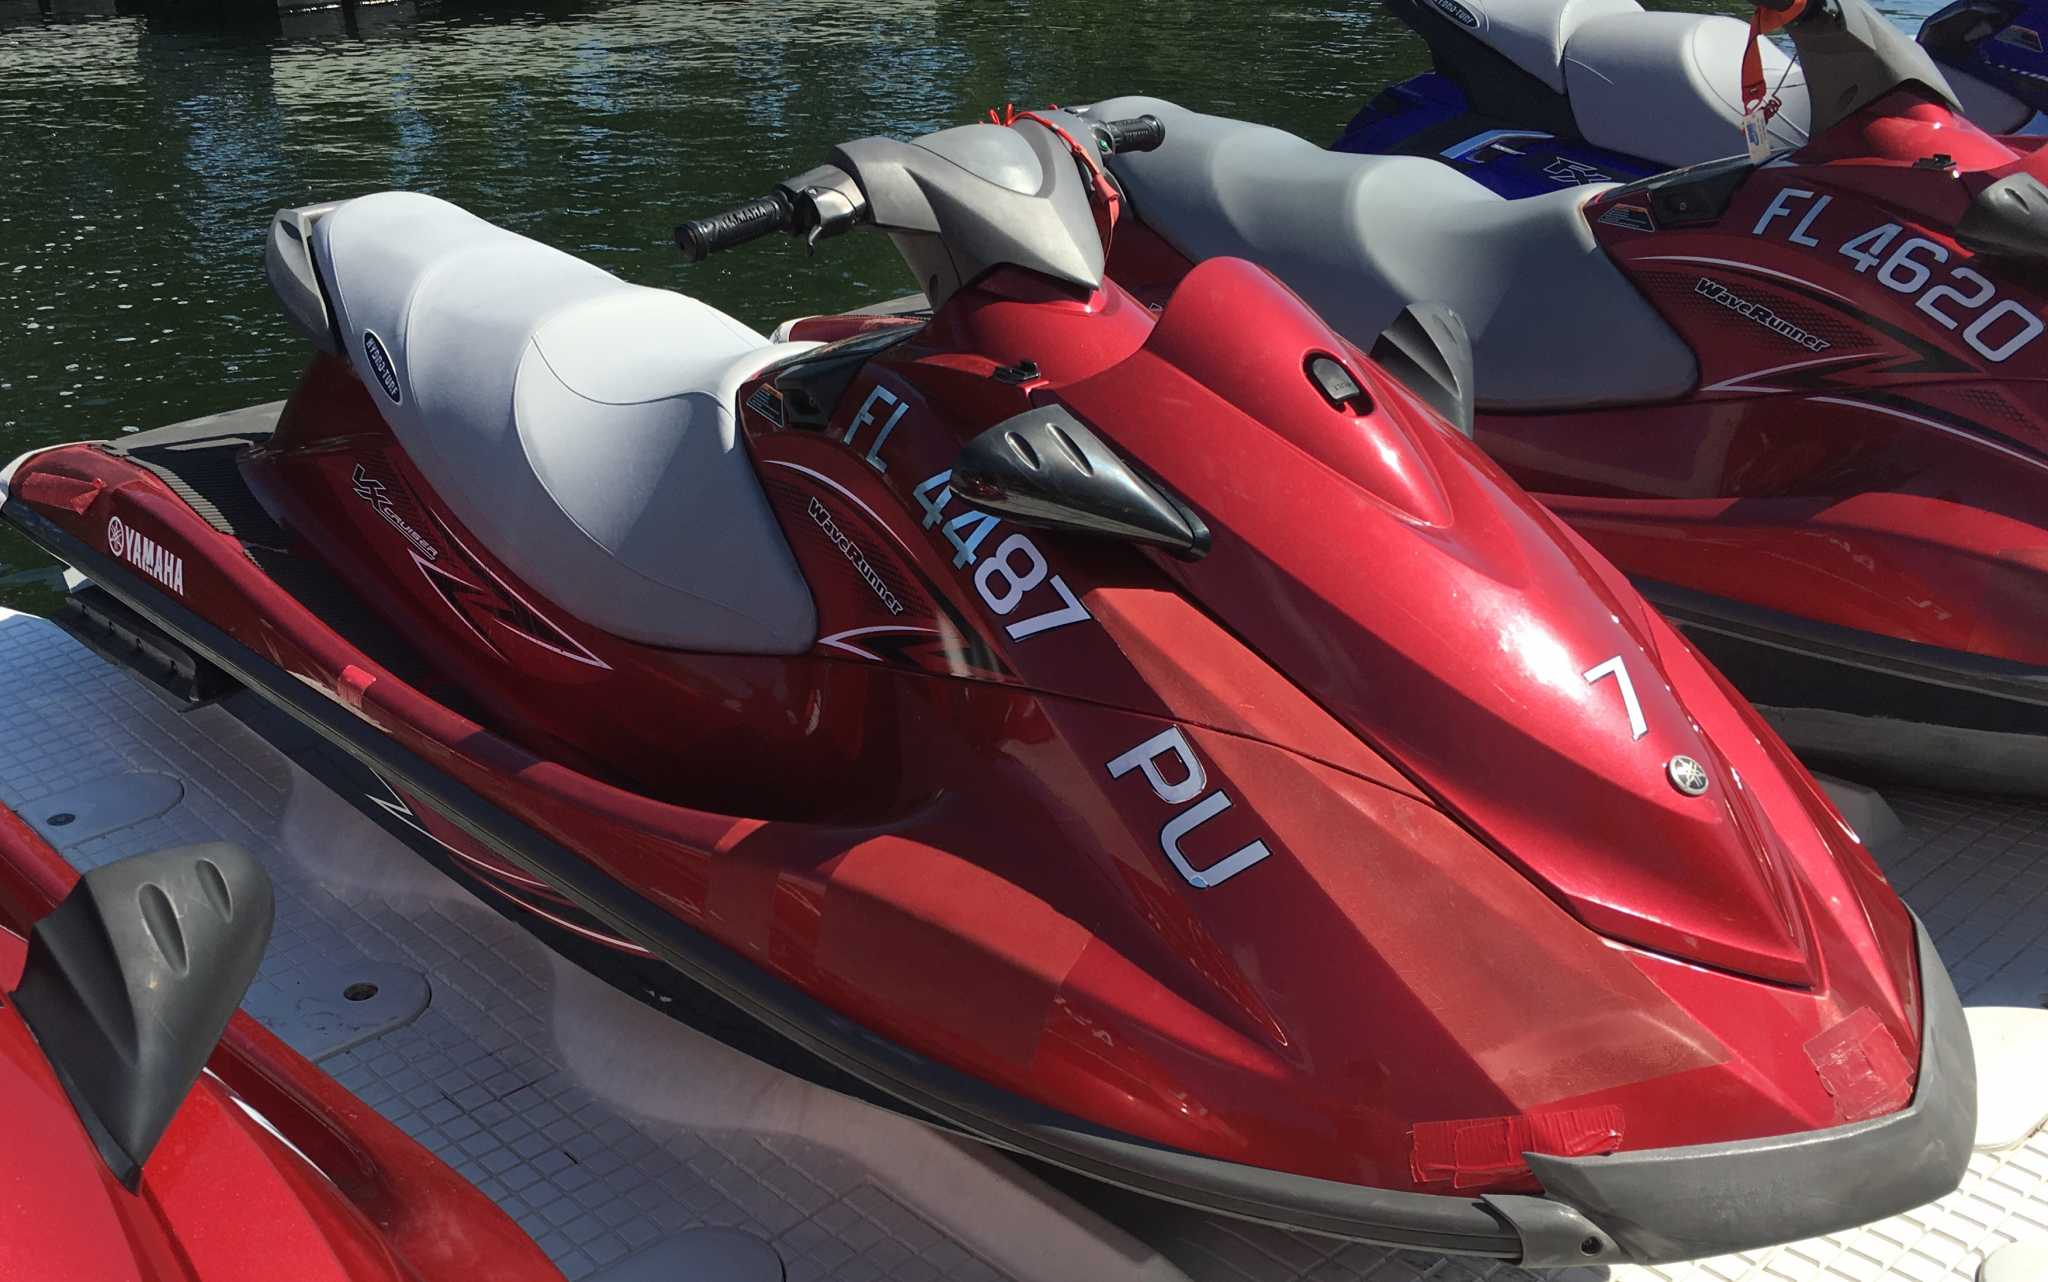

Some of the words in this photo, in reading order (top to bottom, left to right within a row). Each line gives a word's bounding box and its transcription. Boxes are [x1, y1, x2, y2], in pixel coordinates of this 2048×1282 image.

[1695, 277, 1831, 352] WaveRunner
[1752, 187, 1833, 247] FL
[1838, 223, 2045, 362] 4620
[124, 524, 184, 597] YAMAHA
[808, 496, 904, 615] WaveRunner
[843, 385, 909, 473] FL
[913, 469, 1092, 641] 4487
[1582, 655, 1648, 741] 7
[1106, 725, 1273, 889] PU
